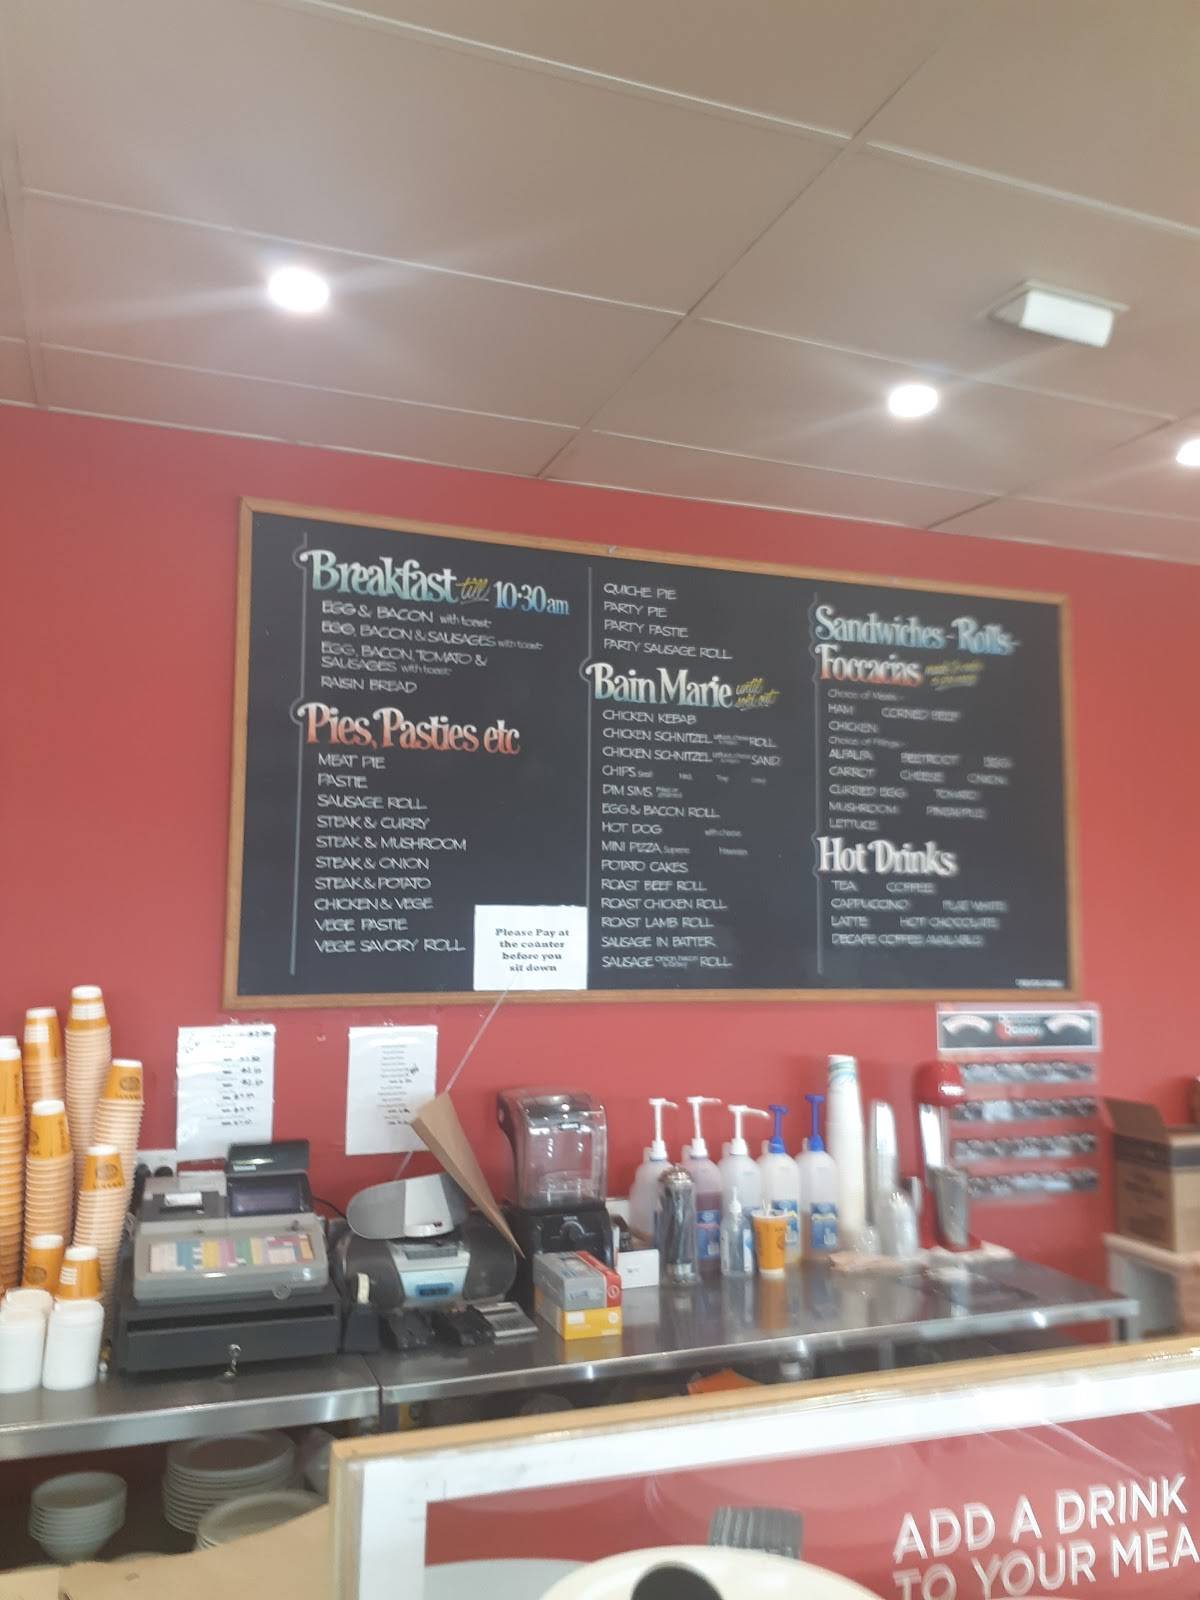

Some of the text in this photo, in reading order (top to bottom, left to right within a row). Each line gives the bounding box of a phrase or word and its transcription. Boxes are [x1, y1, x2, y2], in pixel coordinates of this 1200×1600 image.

[300, 550, 458, 604] Breakfast
[604, 582, 678, 600] QUICHE PIE
[322, 600, 492, 629] EGG & BACON with toast
[604, 601, 668, 618] PARTY PIE
[604, 619, 688, 638] PARTY PASTIE
[815, 605, 946, 649] Sandwiches
[360, 624, 414, 641] BACON
[414, 629, 428, 642] &
[428, 630, 496, 648] SAUSAGES
[604, 638, 733, 660] PARTY SAUSAGE ROLL
[416, 648, 472, 666] TOMATO
[475, 653, 488, 667] &
[320, 656, 453, 676] SAUSAGES with toast
[320, 675, 418, 694] RAISIN BREAD
[585, 662, 656, 704] Bain
[656, 667, 734, 709] Marie
[602, 710, 697, 725] CHICKEN KEBAB
[828, 704, 854, 716] HAM
[373, 708, 480, 753] Pasties
[484, 719, 520, 756] etc
[828, 720, 878, 733] CHICKEN
[603, 728, 651, 741] CHICKEN
[654, 730, 712, 744] SCHNITZEL
[750, 736, 777, 748] ROLL
[318, 752, 386, 770] MEAT PIE
[602, 747, 651, 760] CHICKEN
[654, 750, 712, 762] SCHNITZEL
[602, 764, 637, 778] CHIPS
[317, 772, 368, 789] PASTIE
[602, 784, 624, 796] DIM
[626, 786, 653, 798] SIMS
[317, 793, 428, 810] SAUSAGE ROLL
[602, 802, 720, 818] EGG & BACON ROLL
[317, 814, 430, 830] STEAK & CURRY
[602, 822, 628, 833] HOT
[632, 824, 663, 835] DOG
[829, 818, 878, 830] LETTUCE
[316, 835, 467, 851] STEAK & MUSHROOM
[602, 841, 625, 852] MINI
[630, 842, 663, 854] PIZZA
[316, 855, 430, 871] STEAK & ONION
[817, 836, 959, 877] Hot Drinks
[602, 860, 688, 873] POTATO CAKES
[314, 876, 432, 890] STEAK & POTATO
[602, 878, 707, 891] ROAST BEEF ROLL
[832, 880, 857, 892] TEA
[314, 896, 434, 911] CHICKEN & VEGE
[602, 898, 728, 910] ROAST CHICKEN ROLL
[314, 918, 408, 932] VEGE PASTIE
[602, 917, 714, 928] ROAST LAMB ROLL
[831, 916, 870, 928] LATTE
[495, 928, 533, 936] Please
[536, 928, 556, 938] Pay
[314, 938, 467, 953] VEGE SAVORY ROLL
[522, 940, 564, 948] counter
[602, 936, 718, 948] SAUSAGE IN BATTER
[502, 952, 539, 960] before
[602, 956, 654, 968] SAUSAGE
[700, 956, 733, 967] ROLL
[510, 964, 557, 972] sit down
[893, 1472, 1188, 1564] ADD A DRINK
[892, 1562, 958, 1600] TO
[972, 1538, 1097, 1600] YOUR
